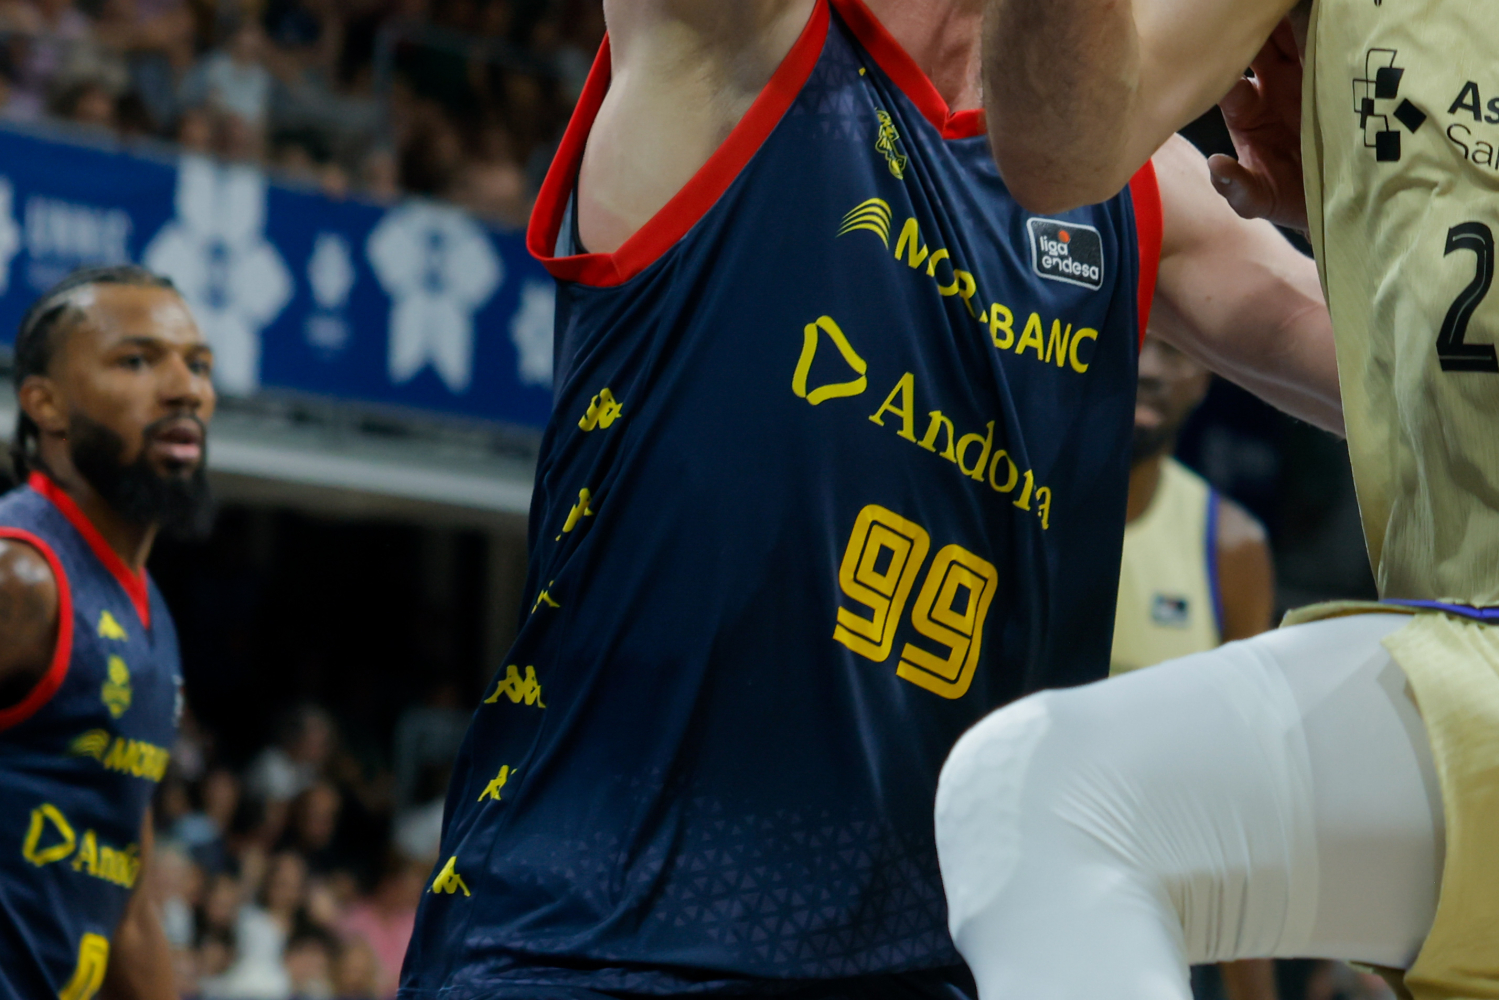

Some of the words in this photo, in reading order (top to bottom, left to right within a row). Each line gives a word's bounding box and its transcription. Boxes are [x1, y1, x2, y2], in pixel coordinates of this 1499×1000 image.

[1040, 235, 1069, 257] liga
[1041, 255, 1099, 280] endesa
[894, 217, 1099, 374] MORBANC
[833, 504, 998, 700] 99
